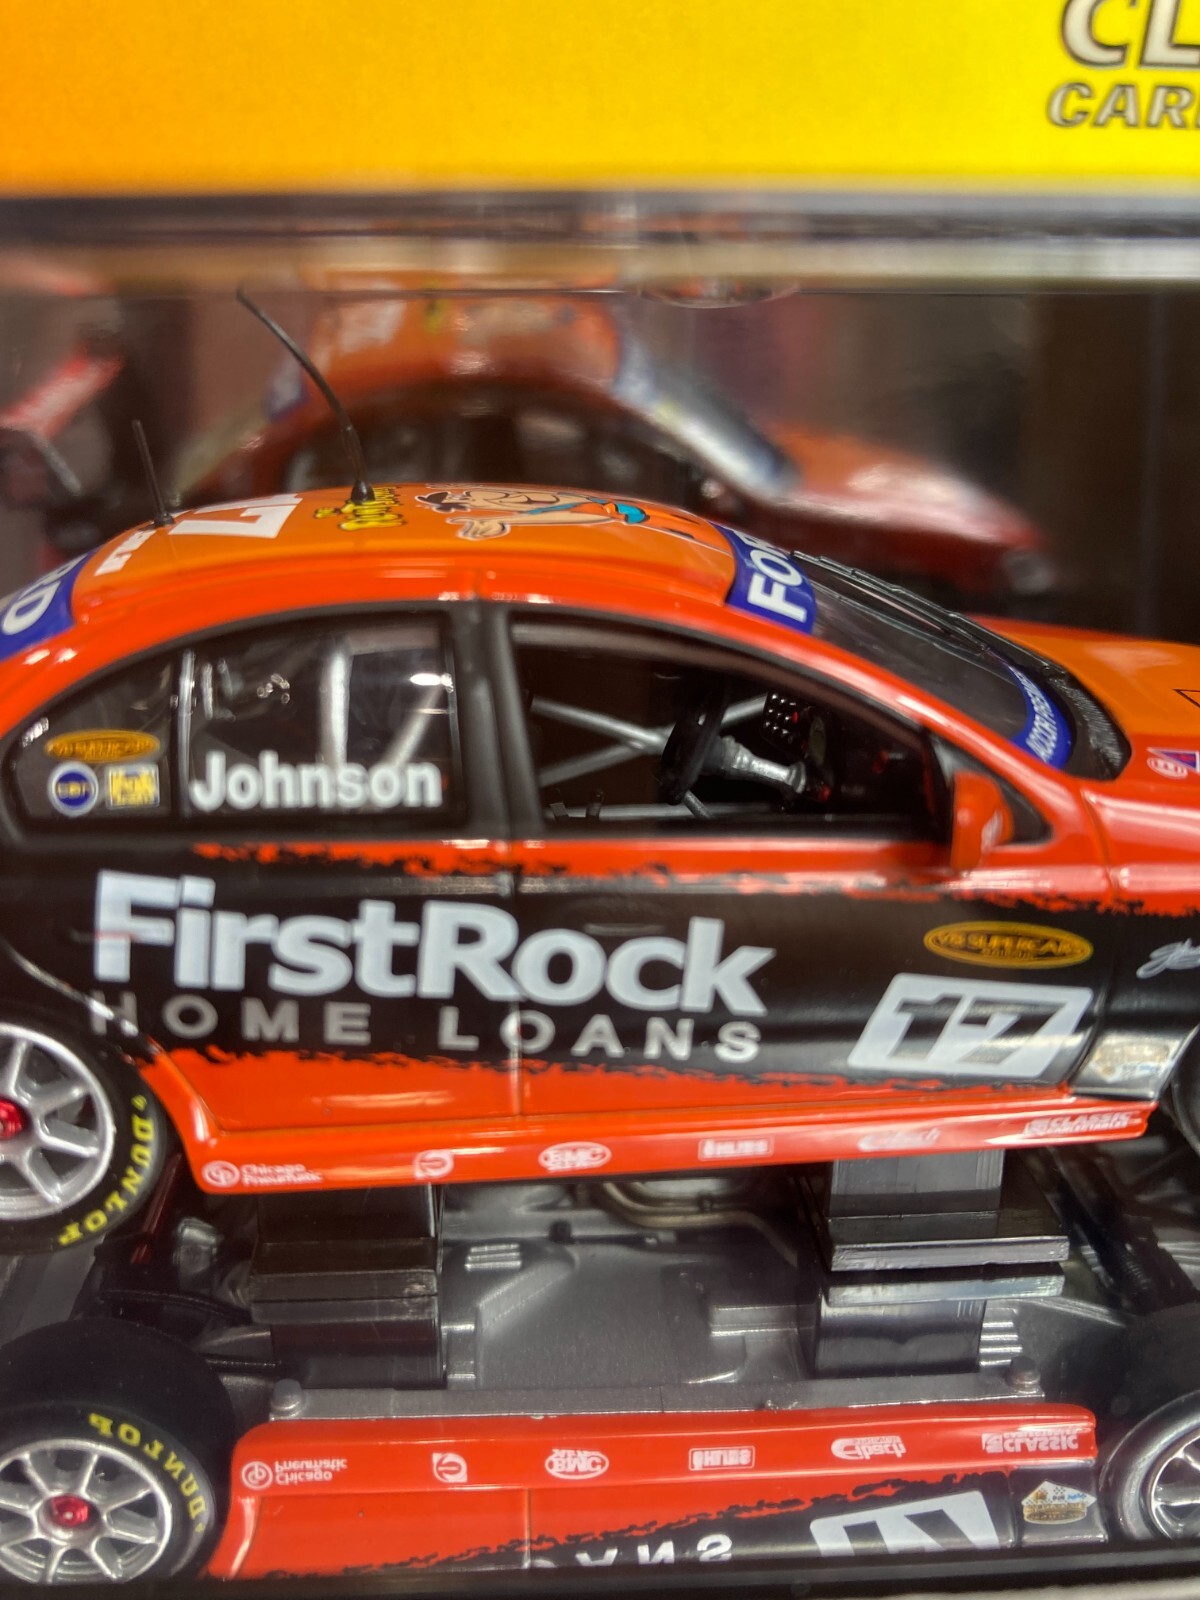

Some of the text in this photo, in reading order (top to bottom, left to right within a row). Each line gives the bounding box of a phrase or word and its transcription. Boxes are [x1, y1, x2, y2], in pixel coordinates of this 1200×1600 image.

[1049, 82, 1200, 128] CAR
[733, 531, 807, 623] FOR
[192, 751, 443, 811] Johnson
[94, 870, 776, 1017] FirstRock
[91, 992, 761, 1063] HOME LOANS
[886, 992, 1071, 1065] 17
[58, 1114, 154, 1246] DUNLOP
